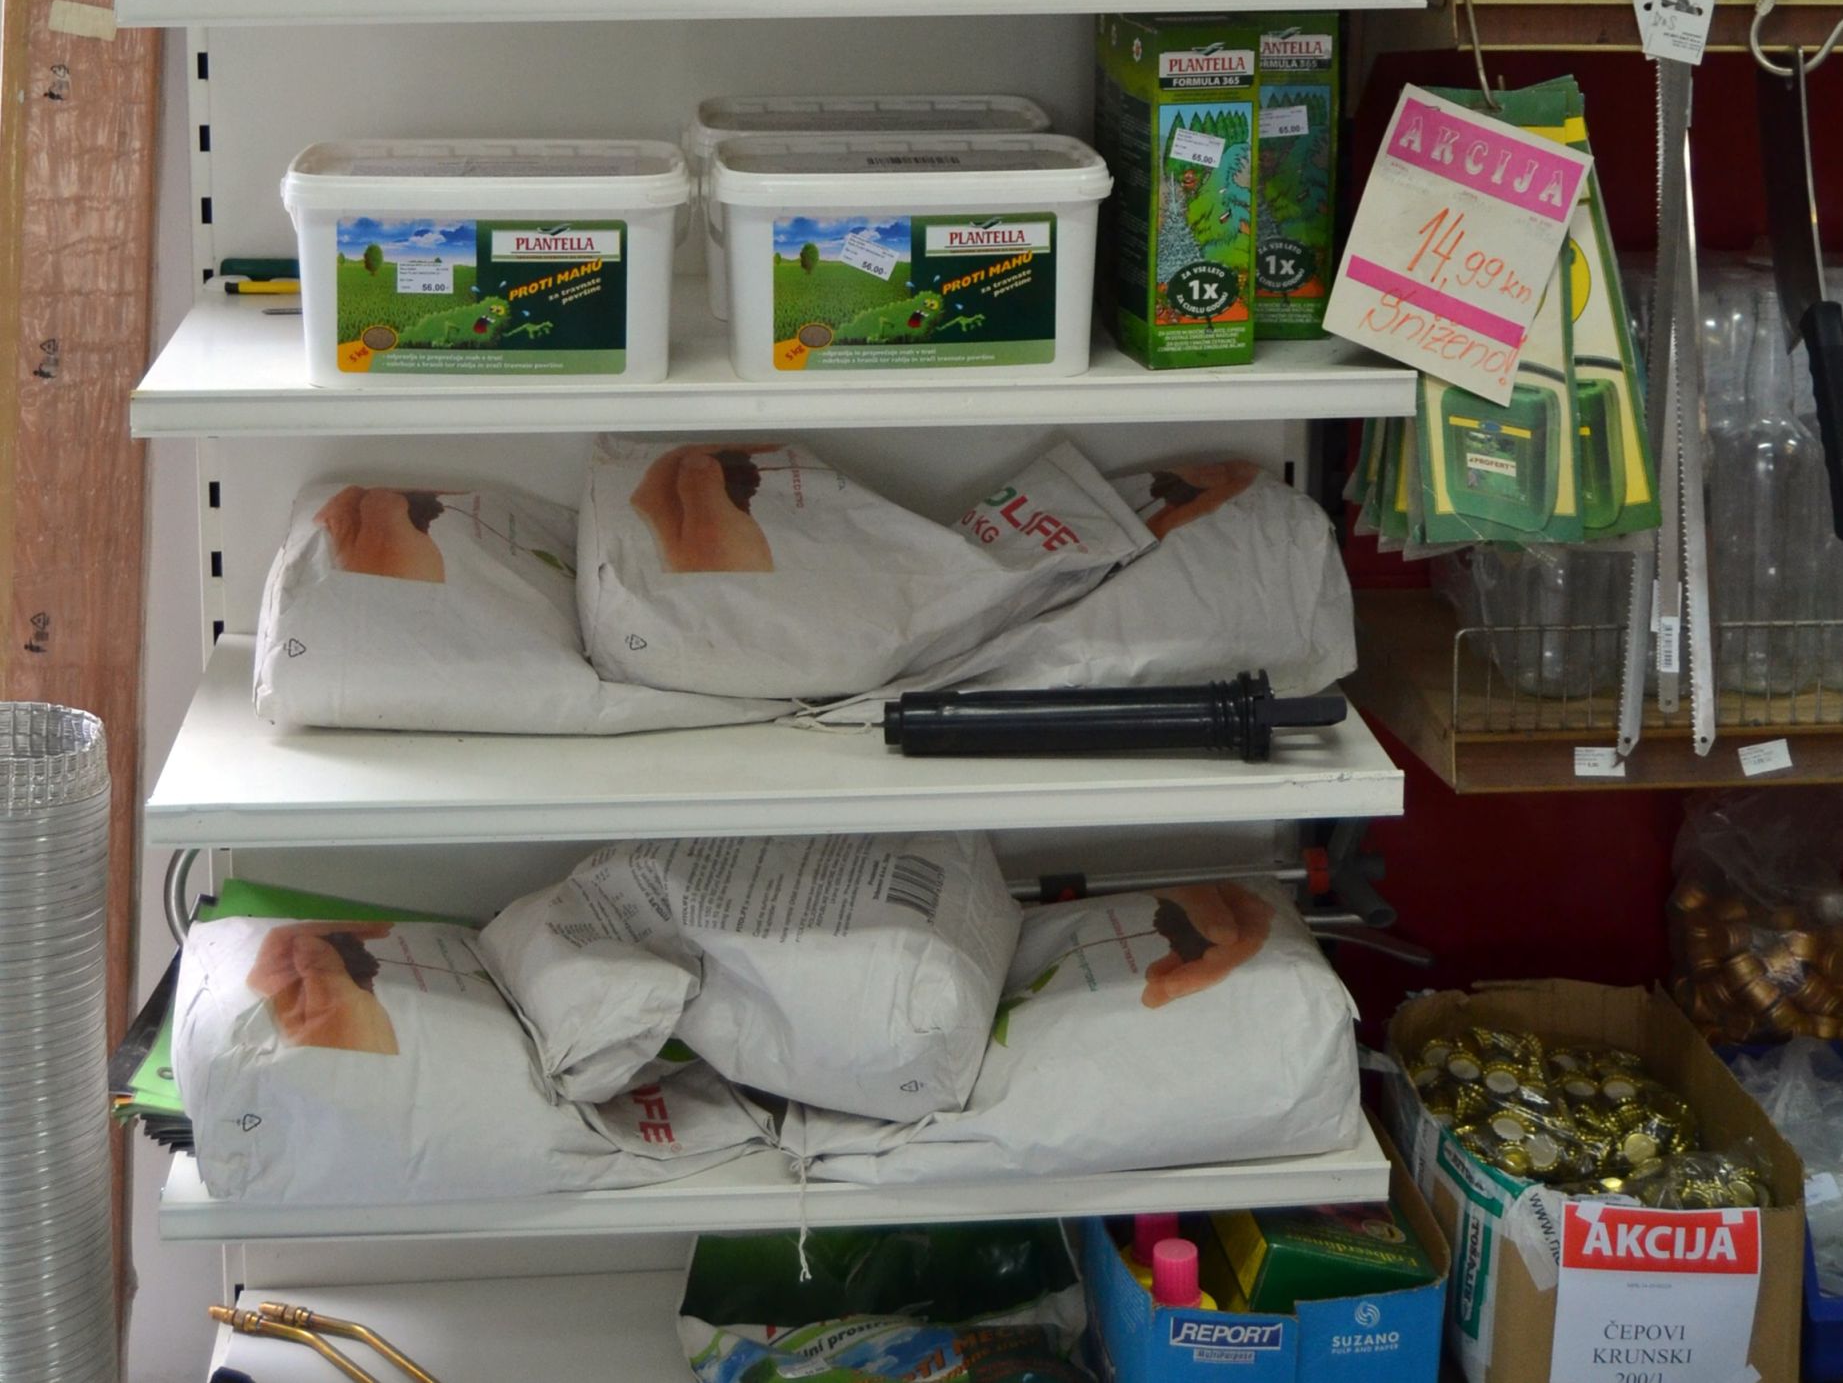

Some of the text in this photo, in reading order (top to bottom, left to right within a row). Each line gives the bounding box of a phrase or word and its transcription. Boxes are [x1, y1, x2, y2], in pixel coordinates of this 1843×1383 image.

[1169, 56, 1246, 72] PLANTELLA
[1173, 76, 1241, 87] FORMULA 365
[1398, 115, 1564, 208] AKCIJA
[515, 237, 594, 251] PLANTELLA
[949, 230, 1025, 246] PLANTELLA
[1284, 242, 1303, 255] LETO
[942, 250, 1033, 295] PROTI MAHU
[1181, 270, 1192, 280] ZA
[1207, 267, 1225, 278] LETO
[1265, 254, 1296, 275] 1x
[508, 259, 603, 302] PROTI MAHU
[1188, 279, 1219, 300] 1x
[1182, 301, 1205, 314] CIJELU
[1205, 291, 1229, 312] GODINU
[975, 515, 999, 544] KG
[1582, 1221, 1737, 1261] AKCIJA
[1180, 1322, 1273, 1345] REPORT
[1331, 1331, 1400, 1348] SUZANO
[1603, 1320, 1686, 1341] ČEPOVI
[1331, 1346, 1352, 1355] PULP
[1374, 1343, 1399, 1352] PAPER
[1592, 1348, 1693, 1365] KRUNSKI
